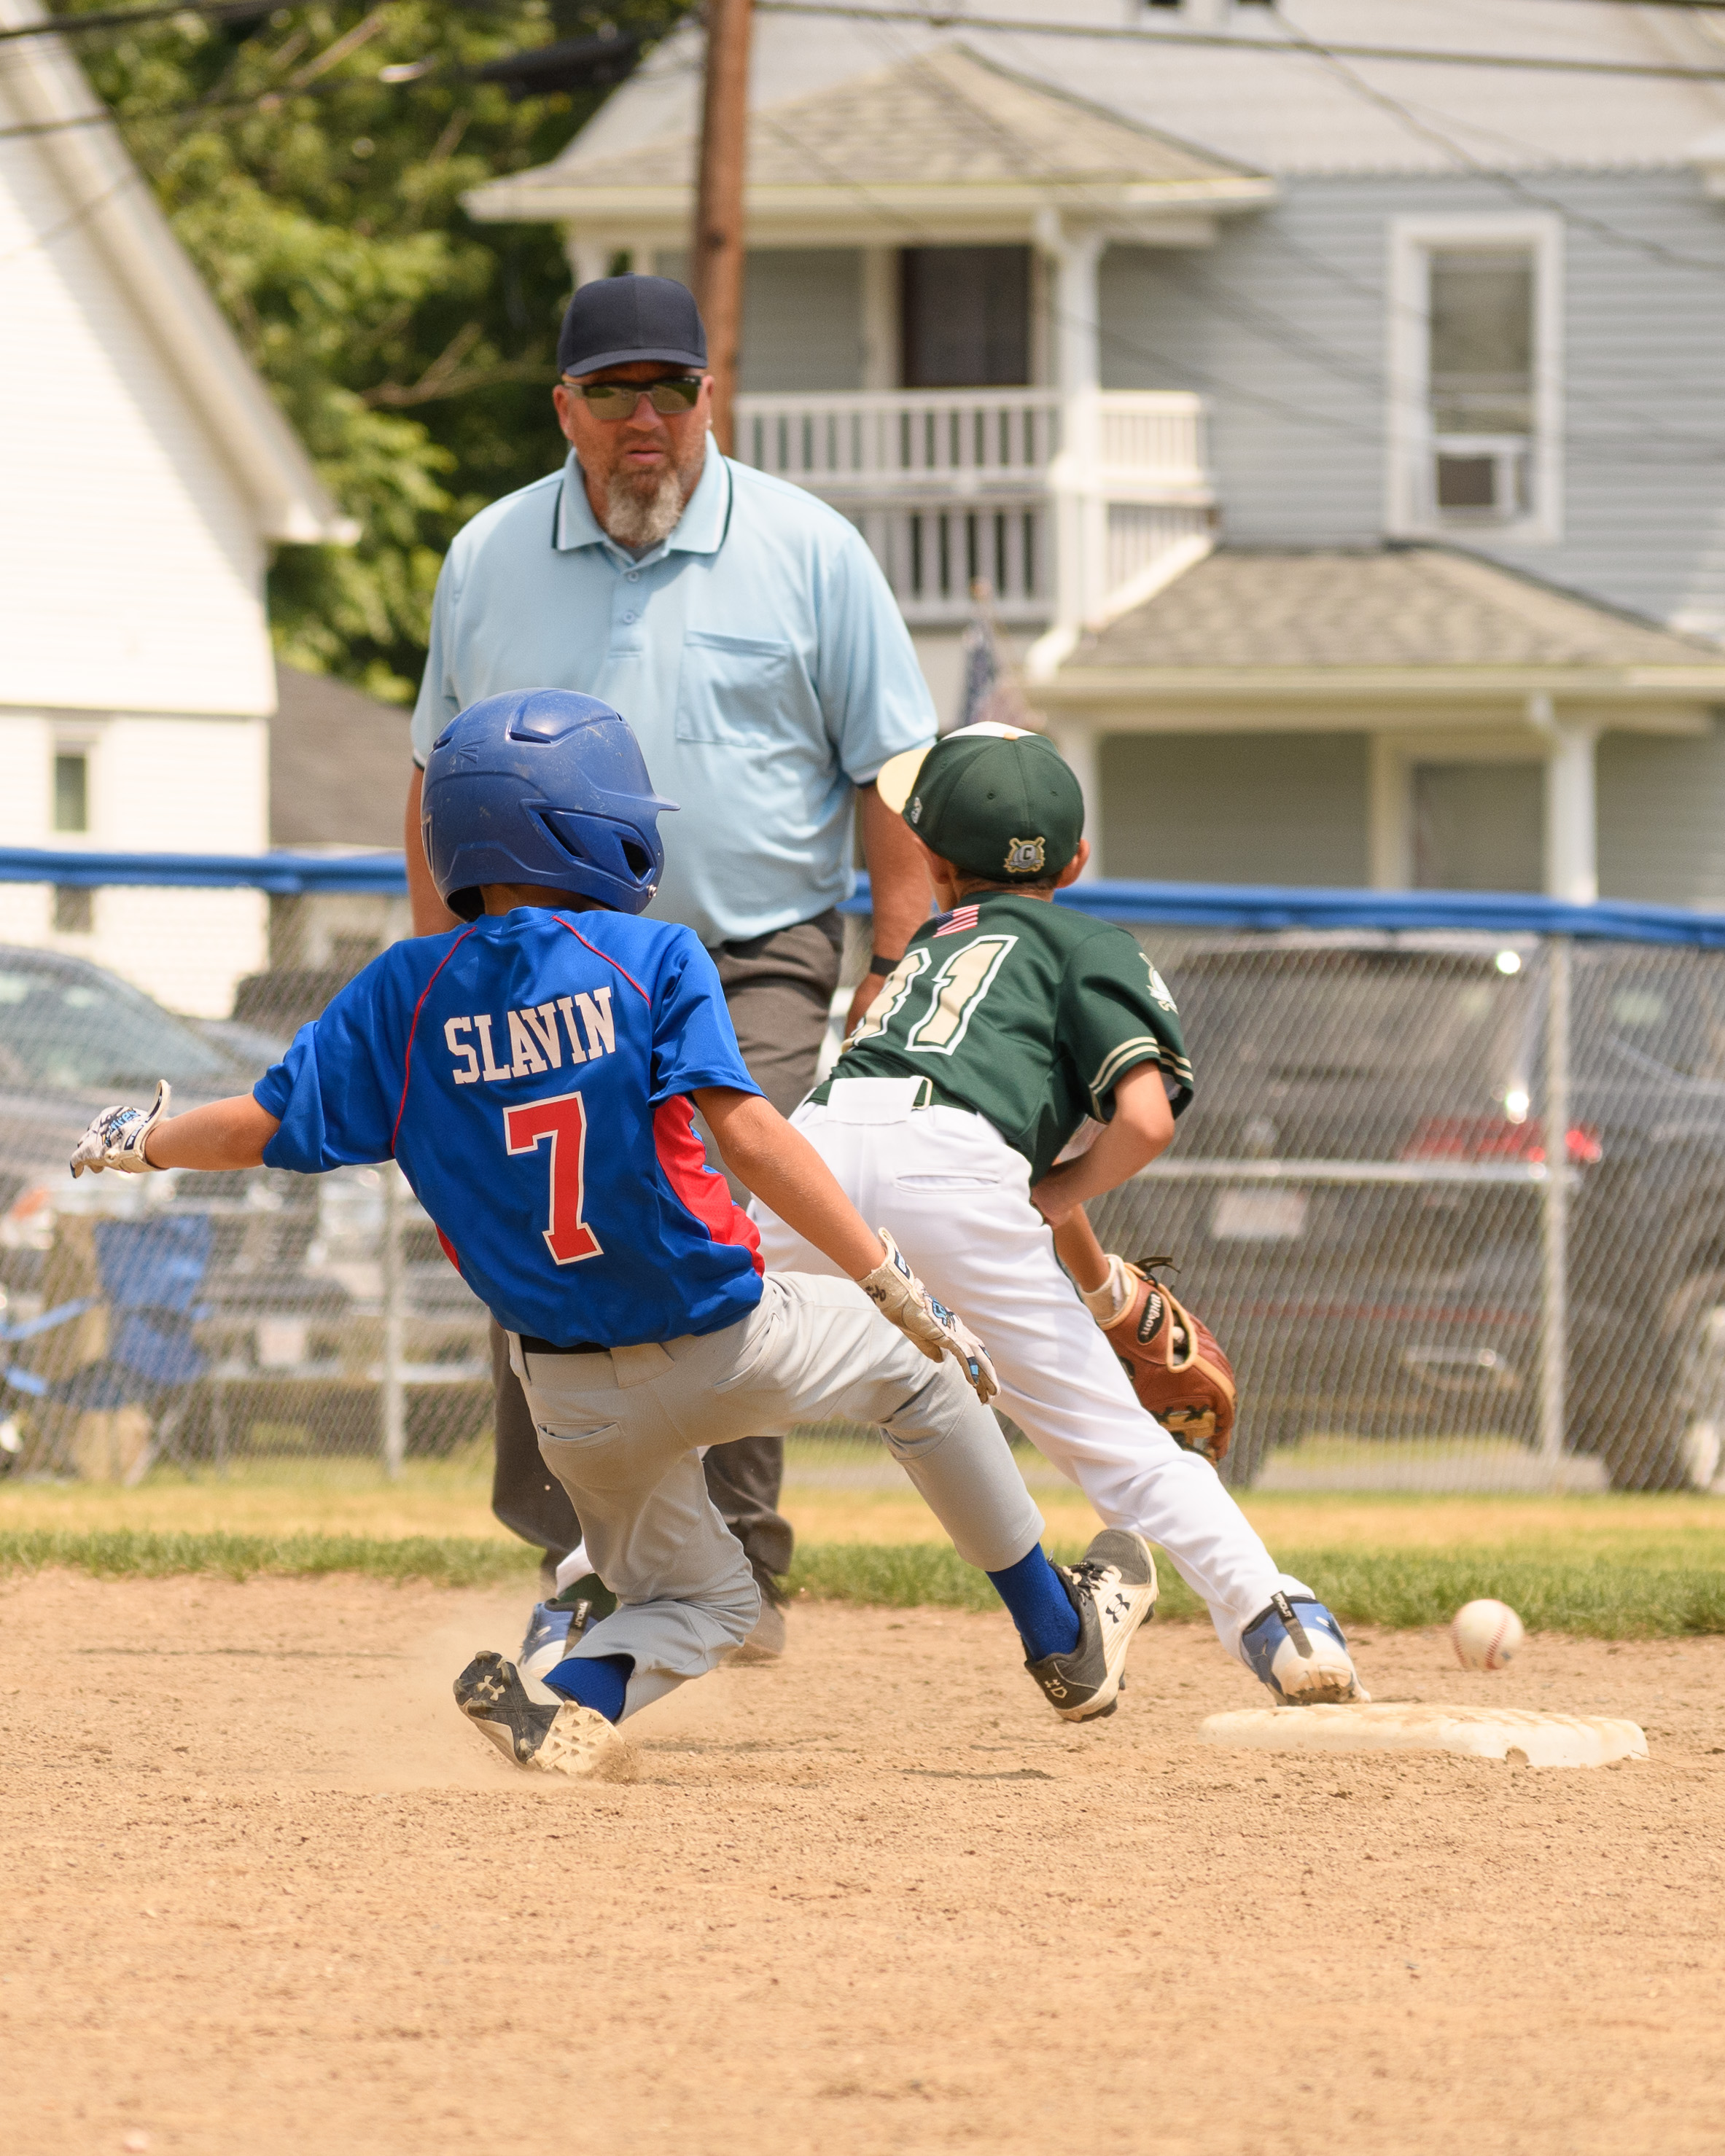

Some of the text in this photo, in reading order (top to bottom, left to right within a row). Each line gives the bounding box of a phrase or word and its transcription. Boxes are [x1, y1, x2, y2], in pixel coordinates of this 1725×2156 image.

[1022, 846, 1033, 861] C
[444, 986, 615, 1085] SLAVIN
[503, 1091, 604, 1265] 7
[1140, 1294, 1161, 1335] Wilson
